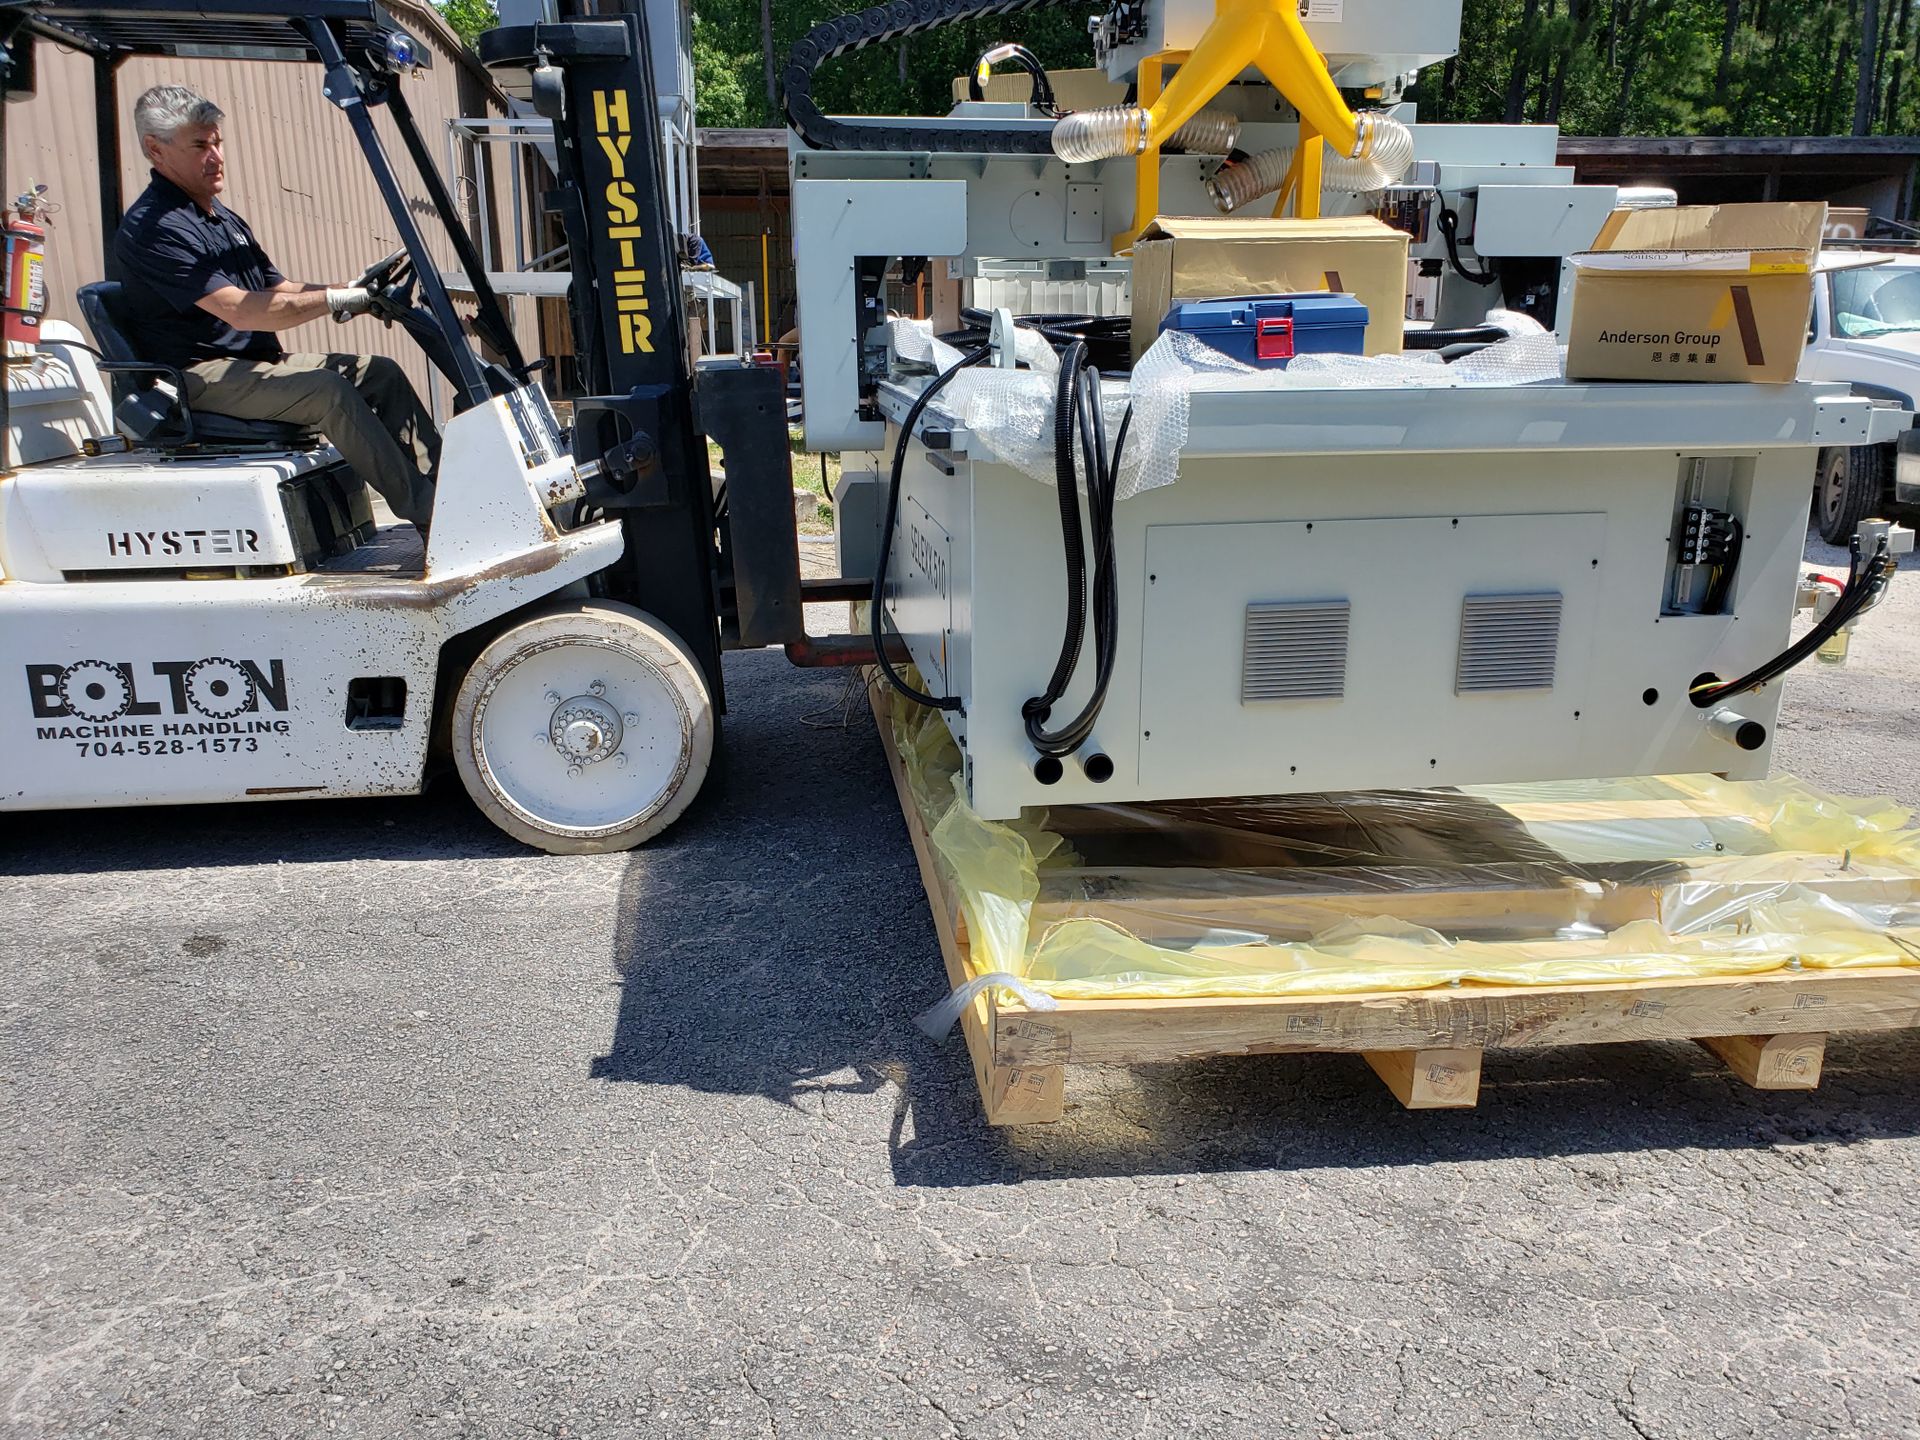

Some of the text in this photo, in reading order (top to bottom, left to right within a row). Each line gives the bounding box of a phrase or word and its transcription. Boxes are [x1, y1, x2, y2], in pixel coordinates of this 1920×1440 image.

[592, 89, 655, 354] HYSTER
[1598, 330, 1721, 348] Anderson Group
[107, 529, 260, 557] HYSTER
[25, 656, 290, 723] BOLTON
[36, 720, 291, 740] MACHINE HANDLING
[76, 737, 259, 758] 704-528-1573
